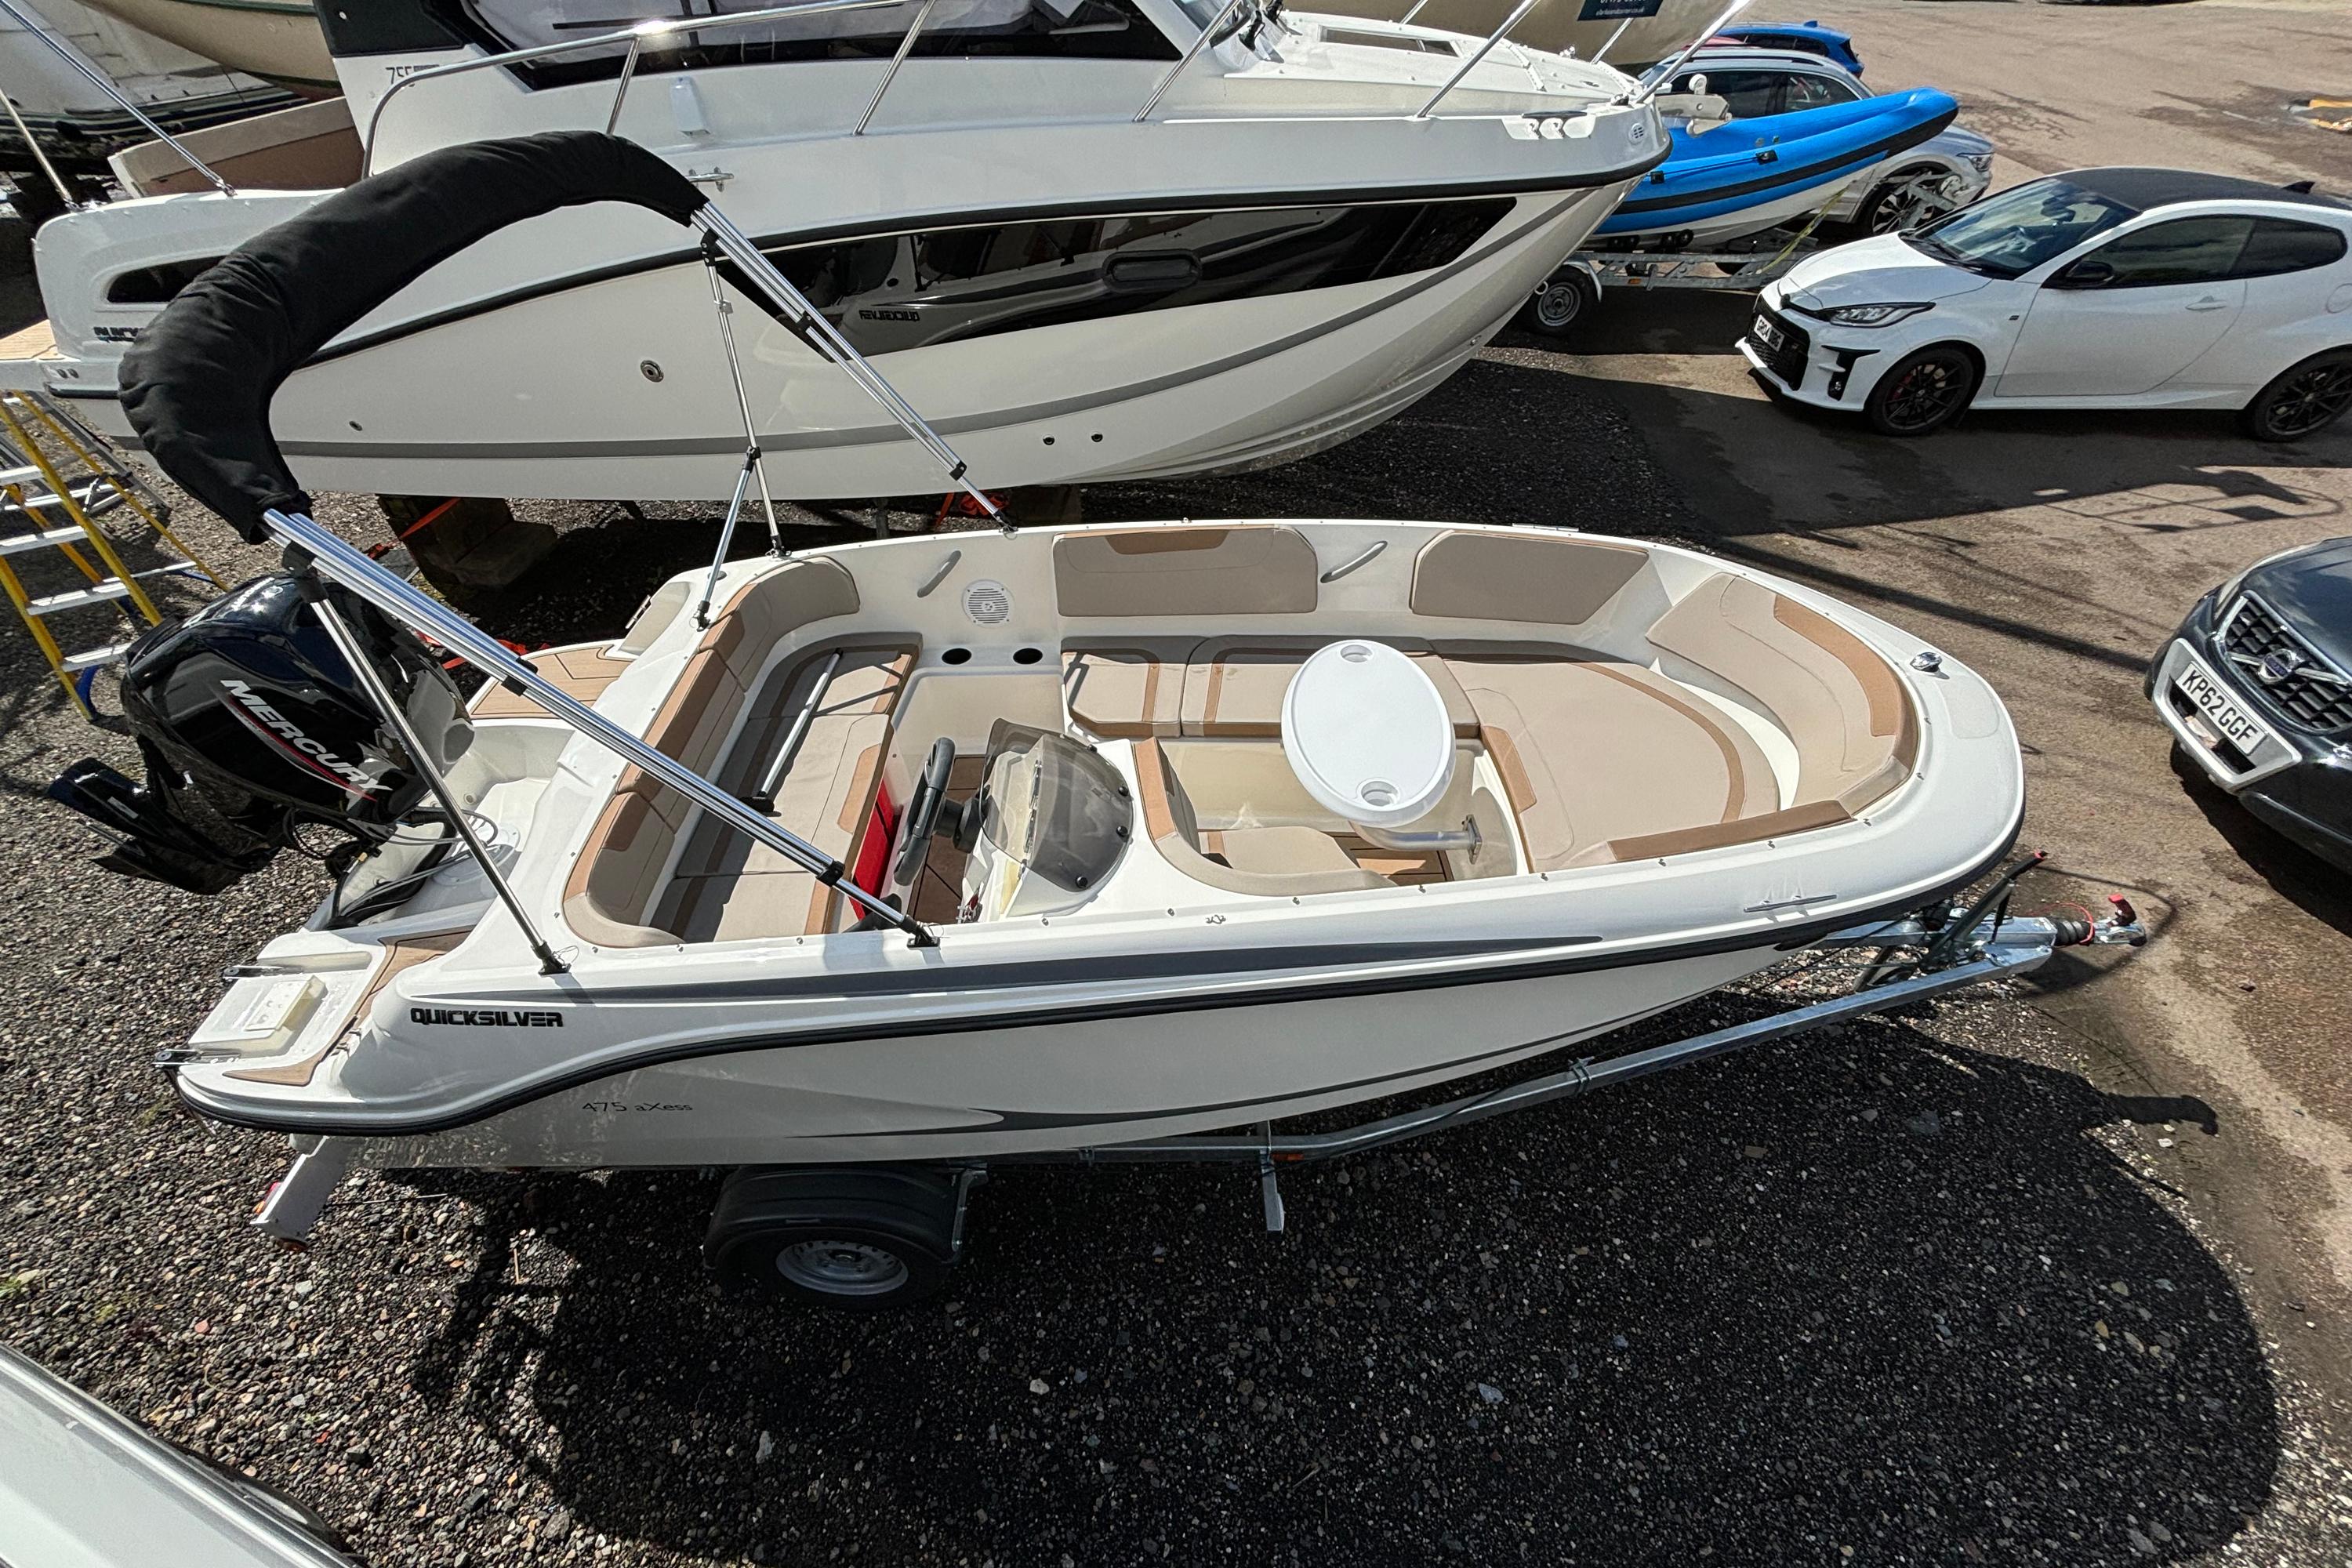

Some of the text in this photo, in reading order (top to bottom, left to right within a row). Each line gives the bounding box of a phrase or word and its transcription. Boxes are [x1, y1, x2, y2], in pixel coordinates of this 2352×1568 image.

[2182, 670, 2258, 742] KP62 GGF
[220, 680, 393, 790] MERCURY
[410, 1007, 564, 1027] QUICKSILVER
[582, 1102, 693, 1112] 475 aXess
